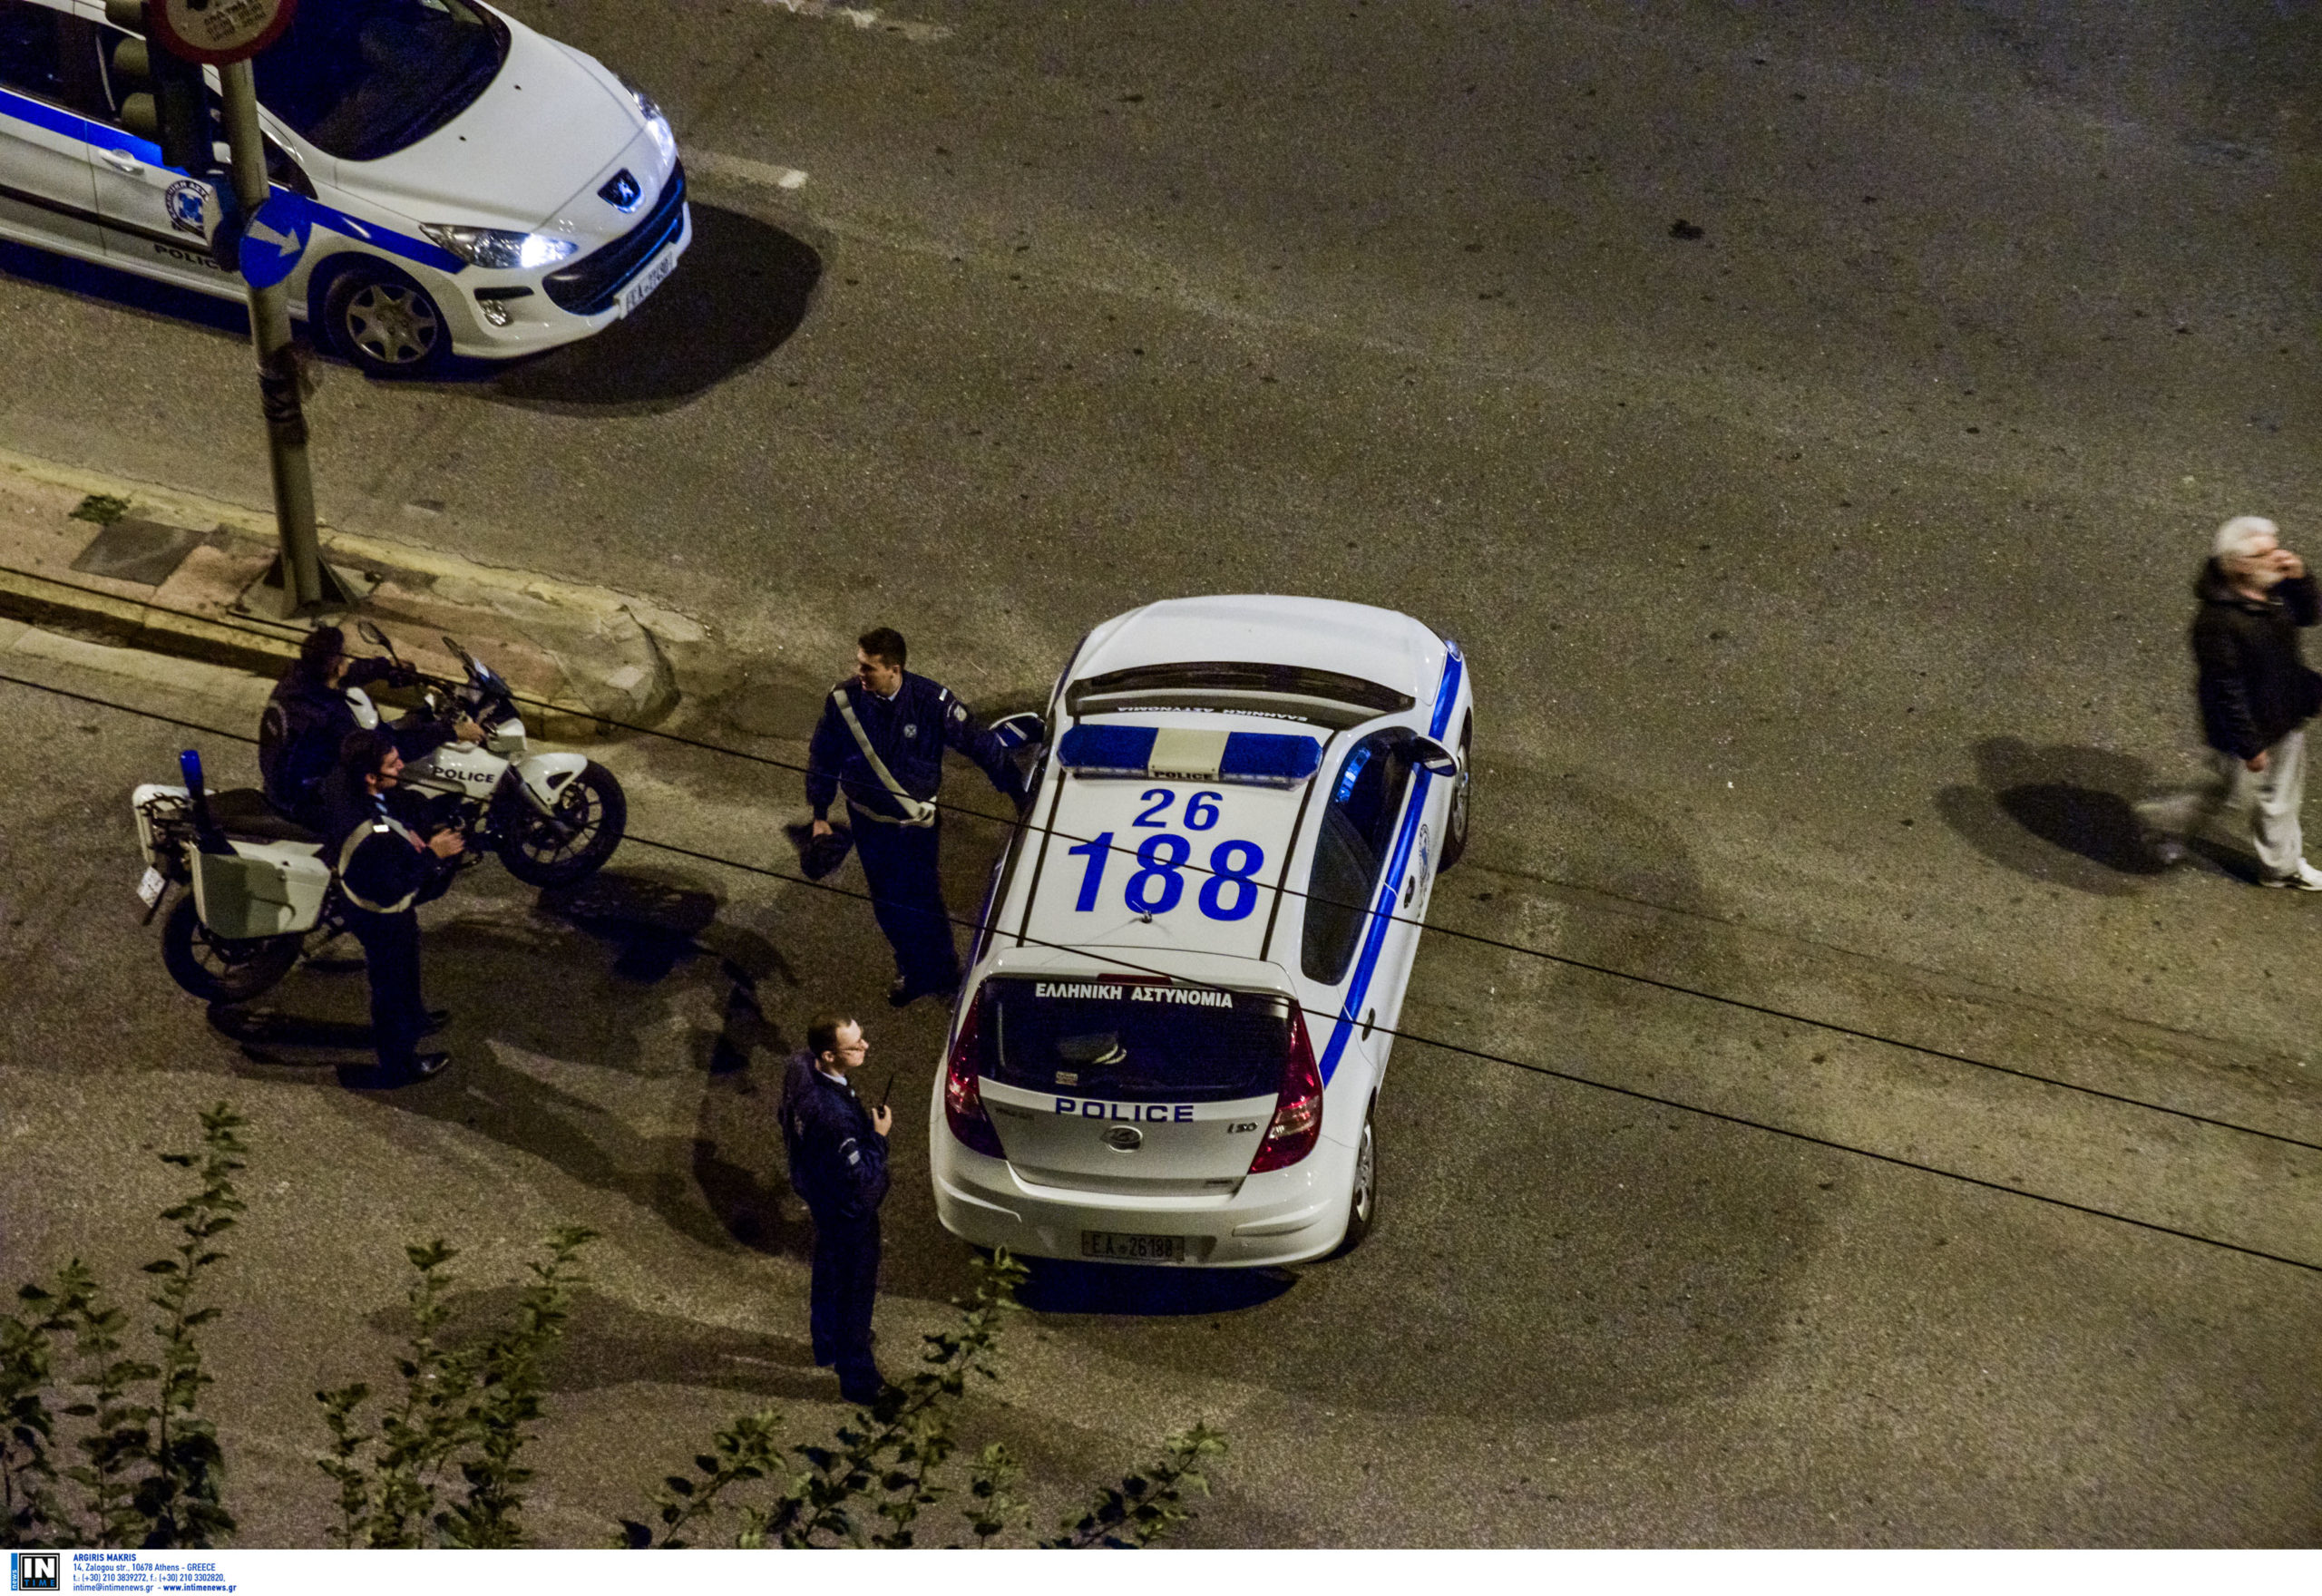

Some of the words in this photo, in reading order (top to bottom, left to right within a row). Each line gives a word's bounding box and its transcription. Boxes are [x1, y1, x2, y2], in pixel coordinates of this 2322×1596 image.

[154, 244, 220, 269] POLIC
[434, 766, 495, 783] POLICE
[1155, 772, 1213, 781] POLICE
[1132, 788, 1223, 831] 26
[1068, 832, 1264, 921] 188
[1035, 983, 1123, 999] ΕΛΛΗΝΙΚΗ
[1131, 987, 1234, 1008] ΑΣΤΥΝΟΜΙΑ
[1056, 1097, 1194, 1123] POLICE
